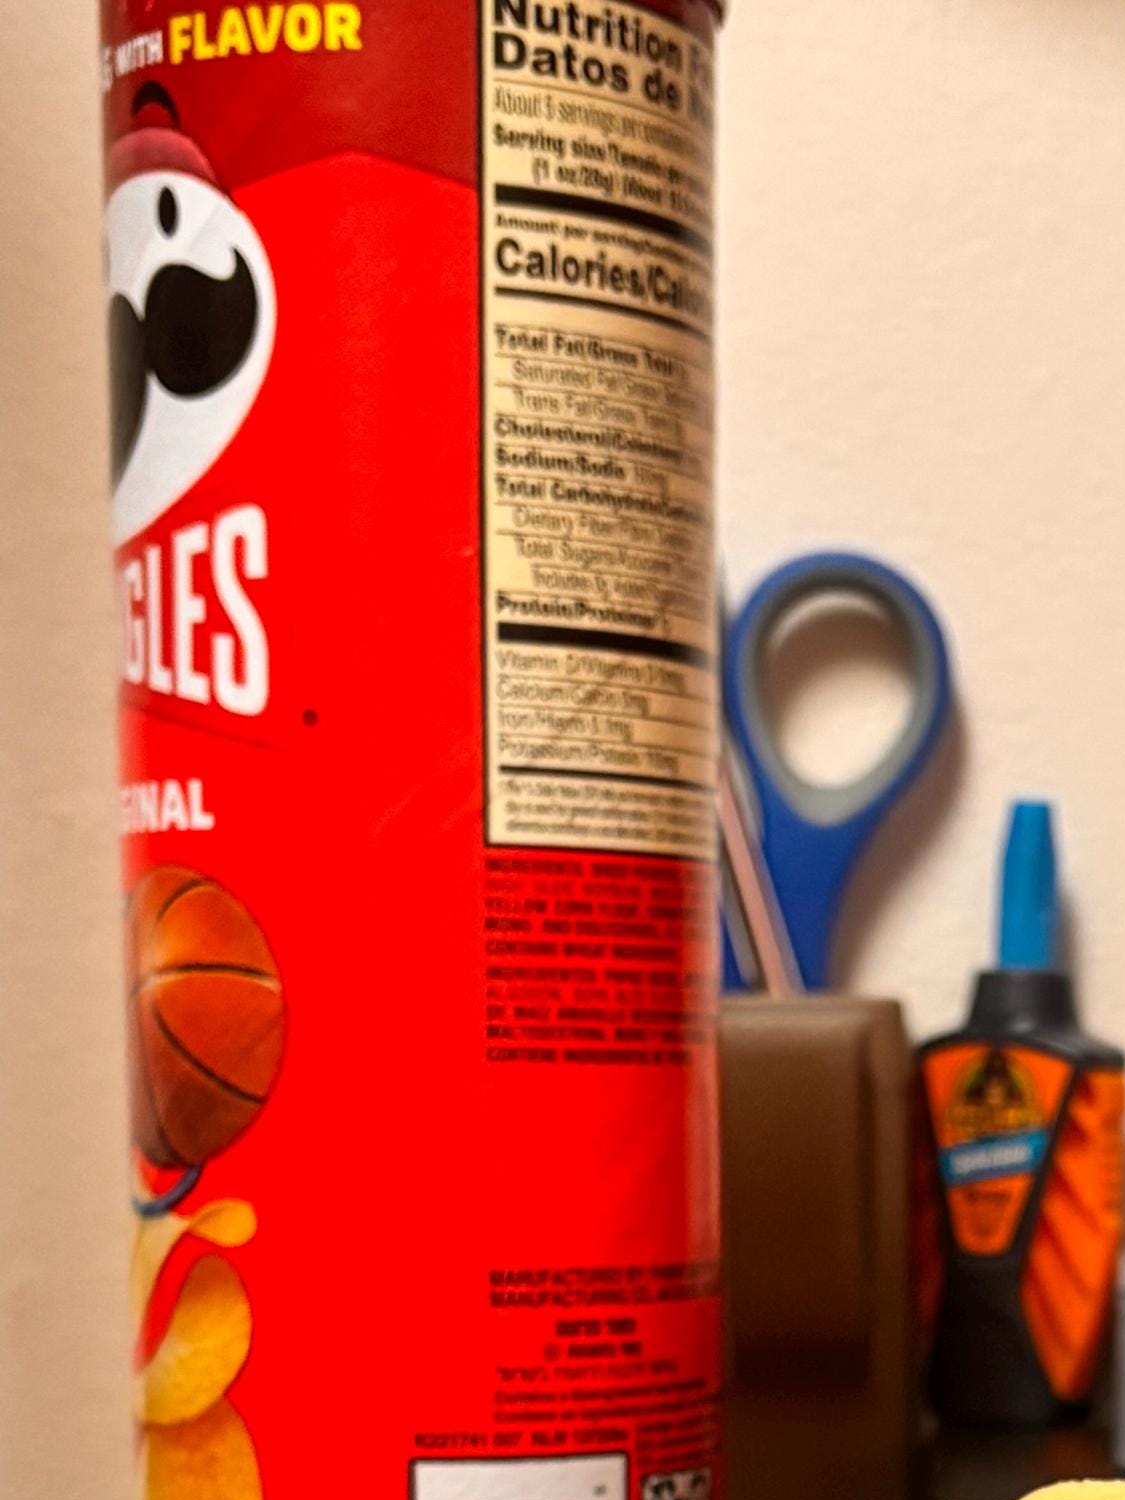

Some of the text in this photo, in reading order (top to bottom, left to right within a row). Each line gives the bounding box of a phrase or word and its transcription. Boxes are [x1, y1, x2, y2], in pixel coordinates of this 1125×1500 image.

[168, 2, 363, 64] FLAVOR
[494, 0, 682, 72] Nutrition
[494, 31, 629, 92] Datos
[643, 68, 681, 111] de
